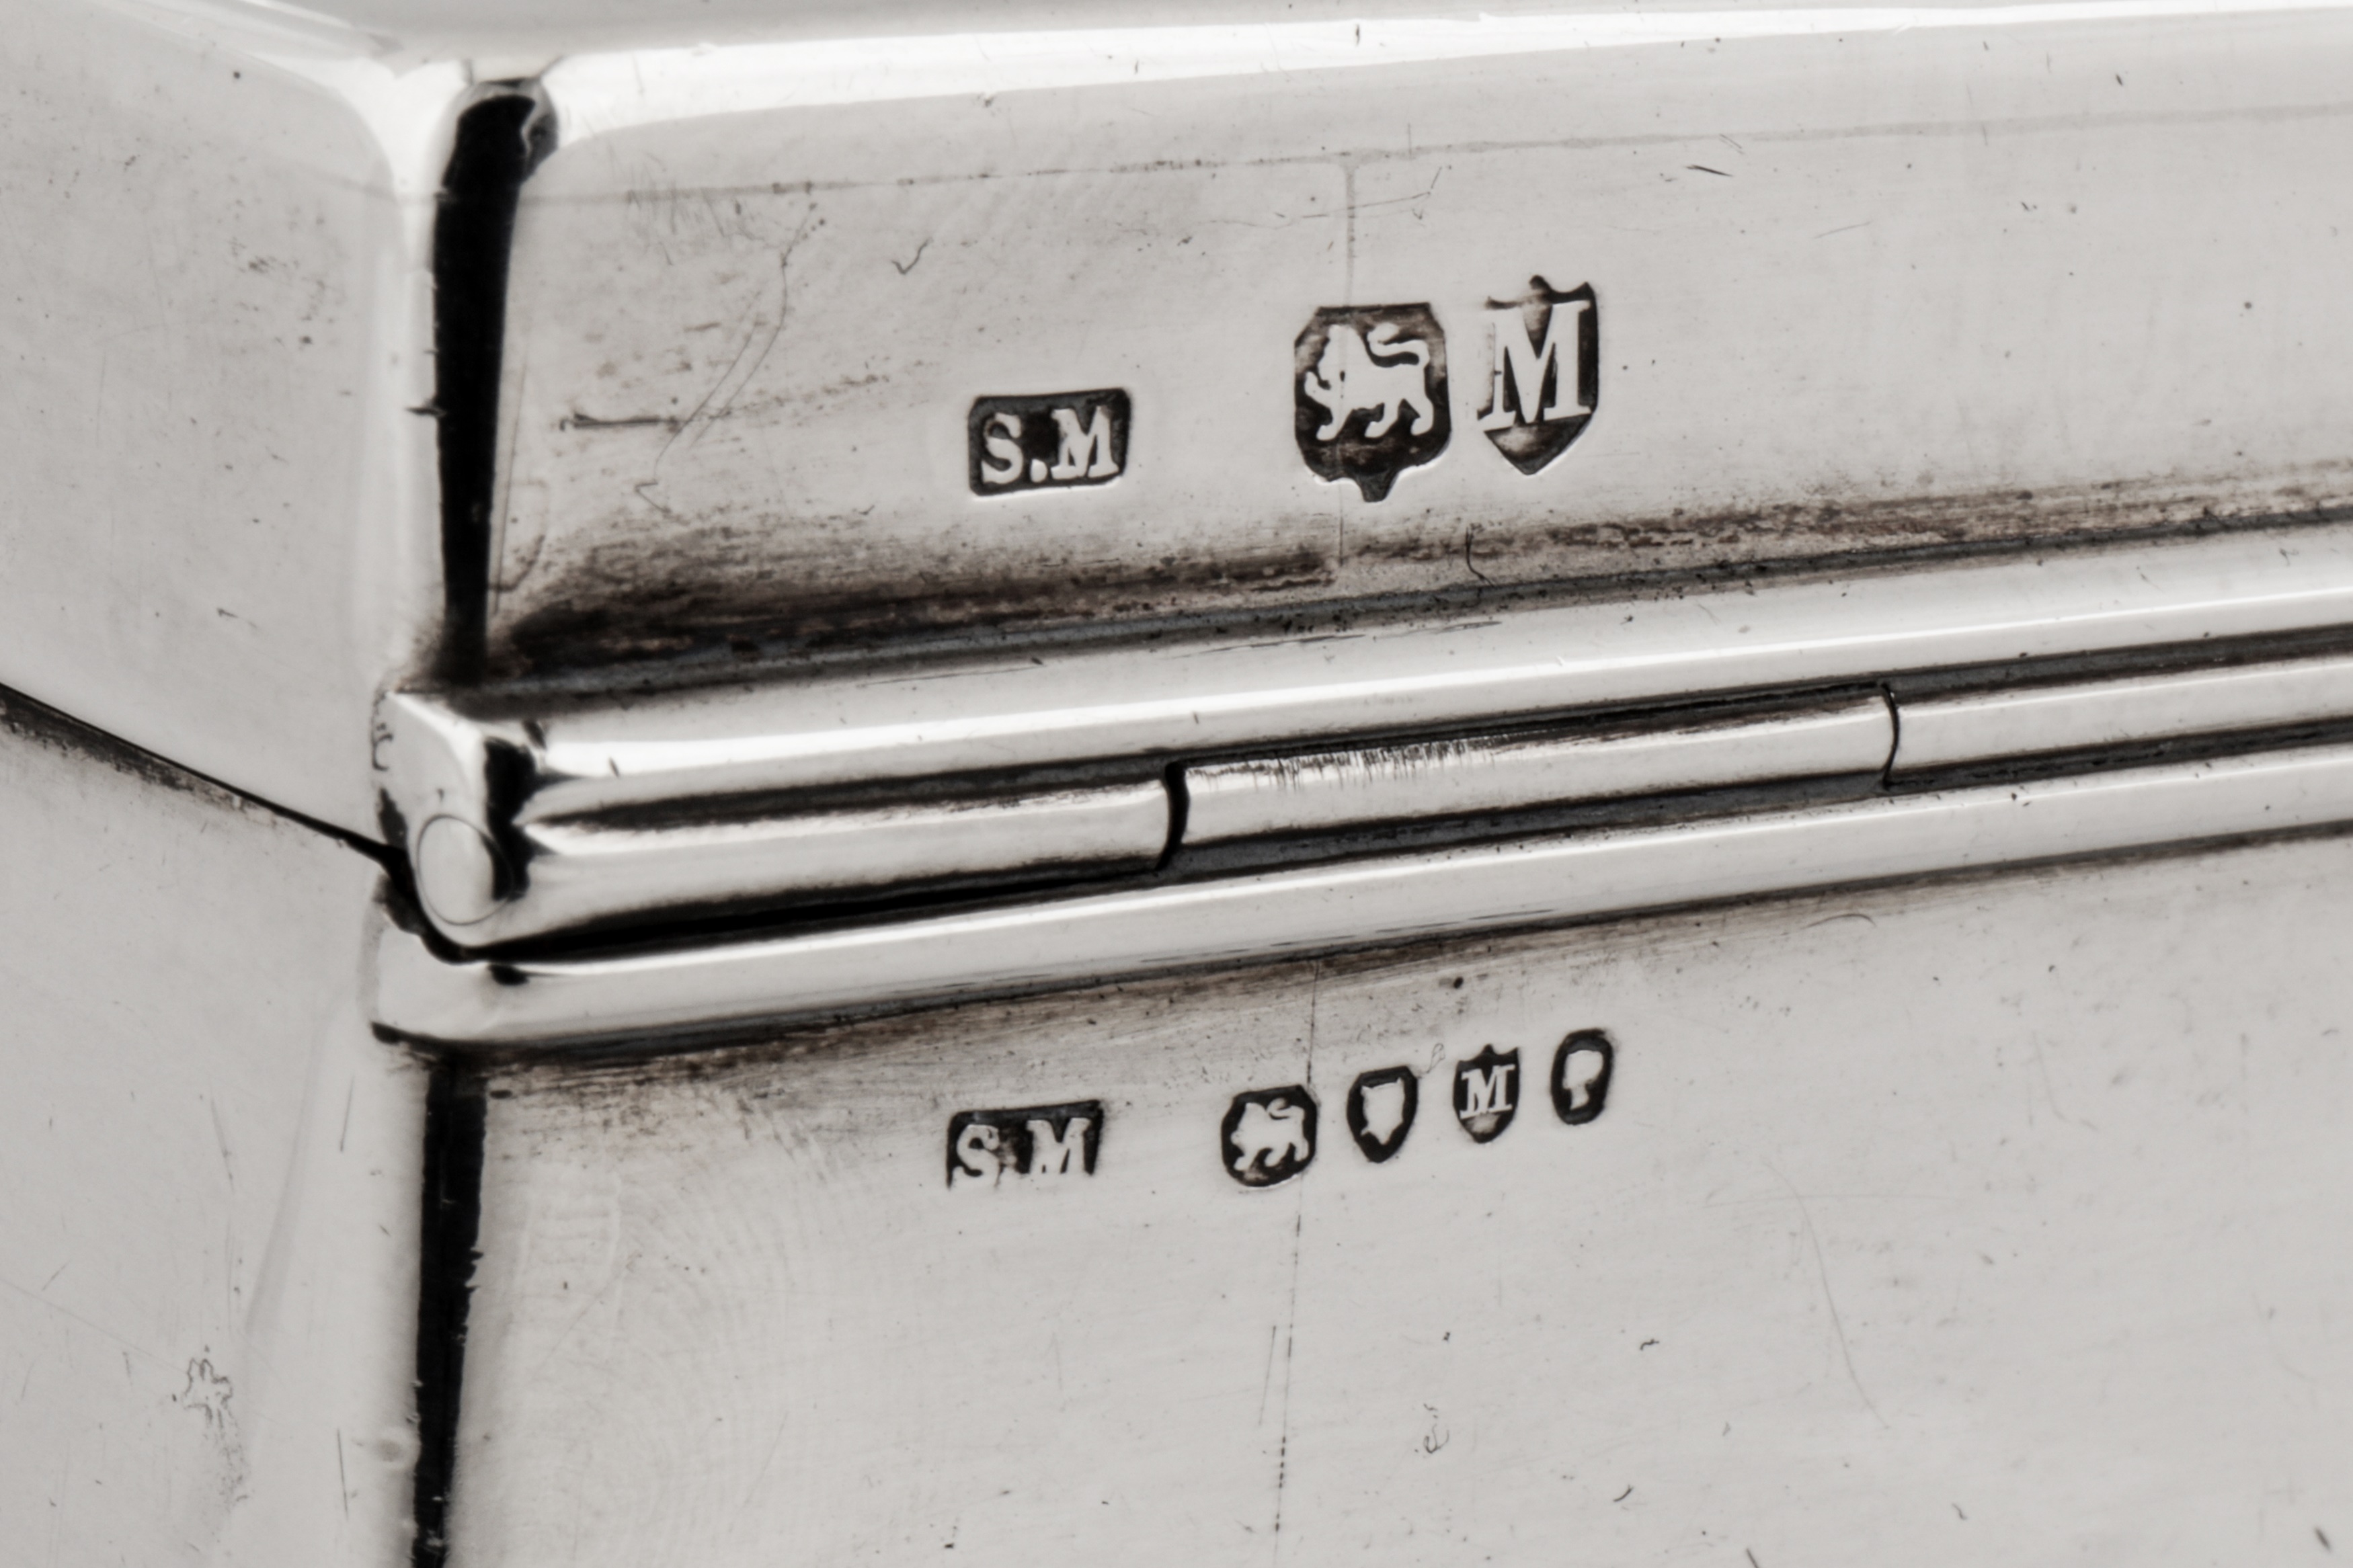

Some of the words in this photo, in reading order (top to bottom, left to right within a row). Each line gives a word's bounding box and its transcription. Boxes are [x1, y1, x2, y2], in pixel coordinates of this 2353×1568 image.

[1476, 300, 1592, 433] M
[980, 405, 1120, 485] S.M
[1459, 1063, 1516, 1120] M
